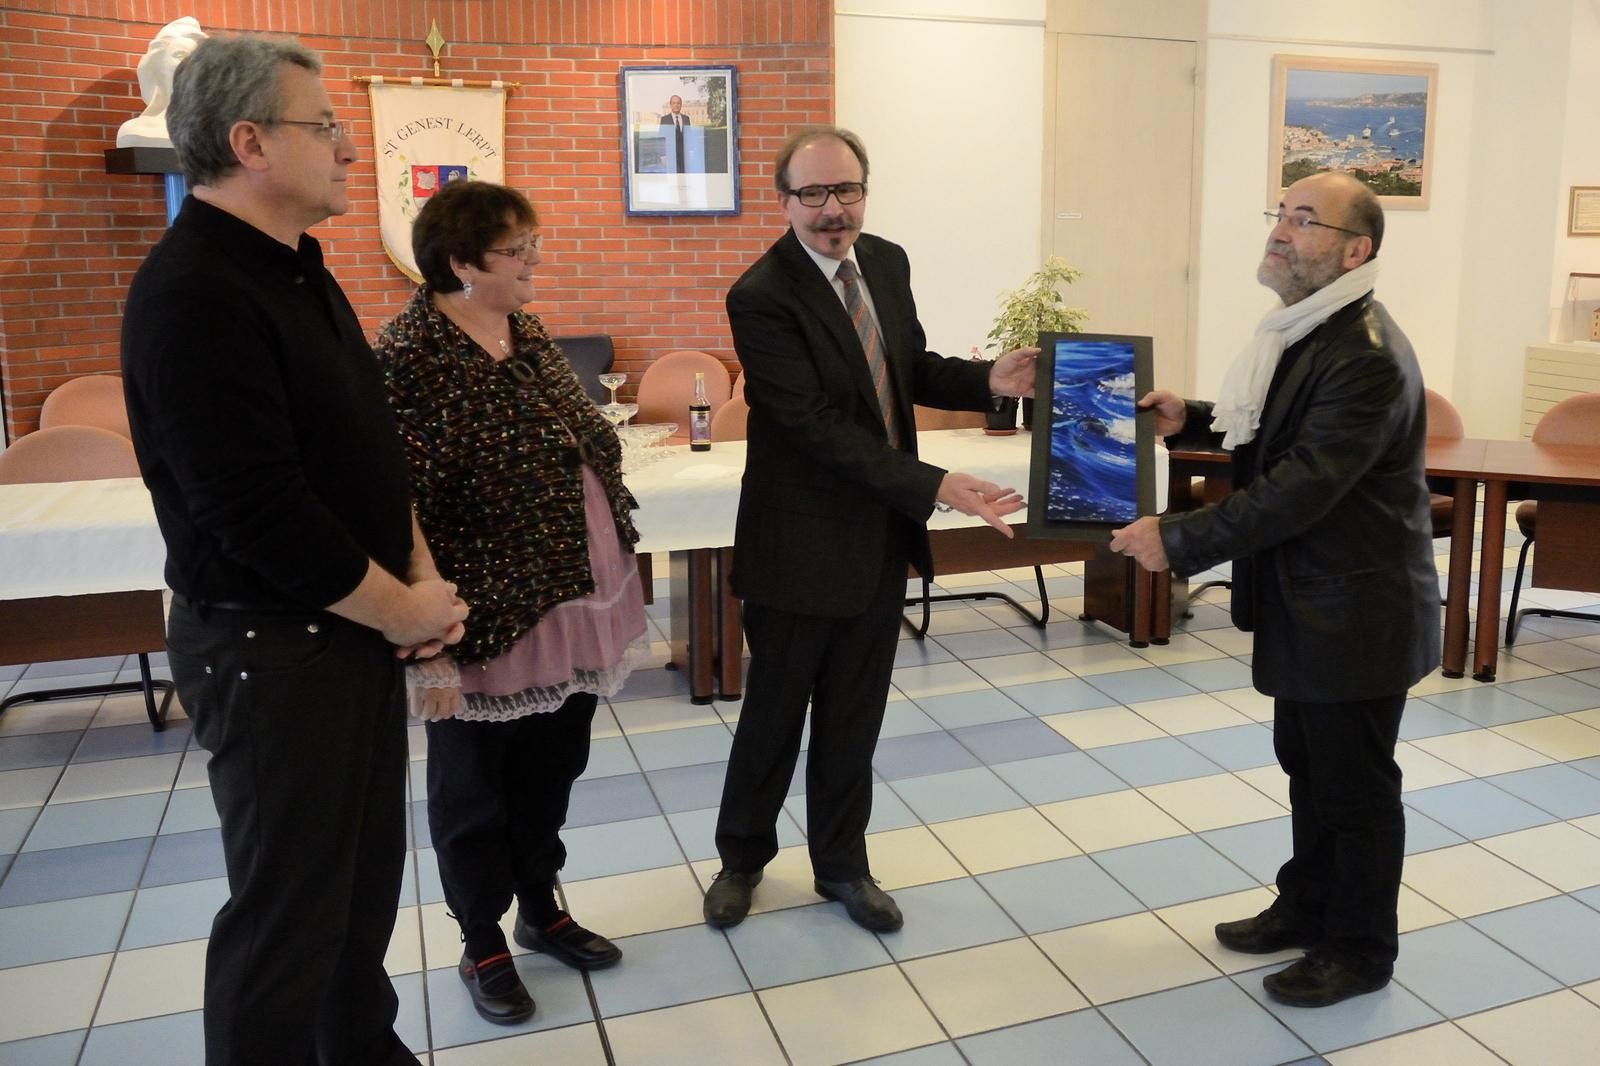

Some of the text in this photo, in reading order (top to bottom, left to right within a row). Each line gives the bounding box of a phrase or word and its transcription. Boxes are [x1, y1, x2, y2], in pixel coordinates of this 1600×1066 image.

[383, 117, 497, 159] ST GENEST LERPT
